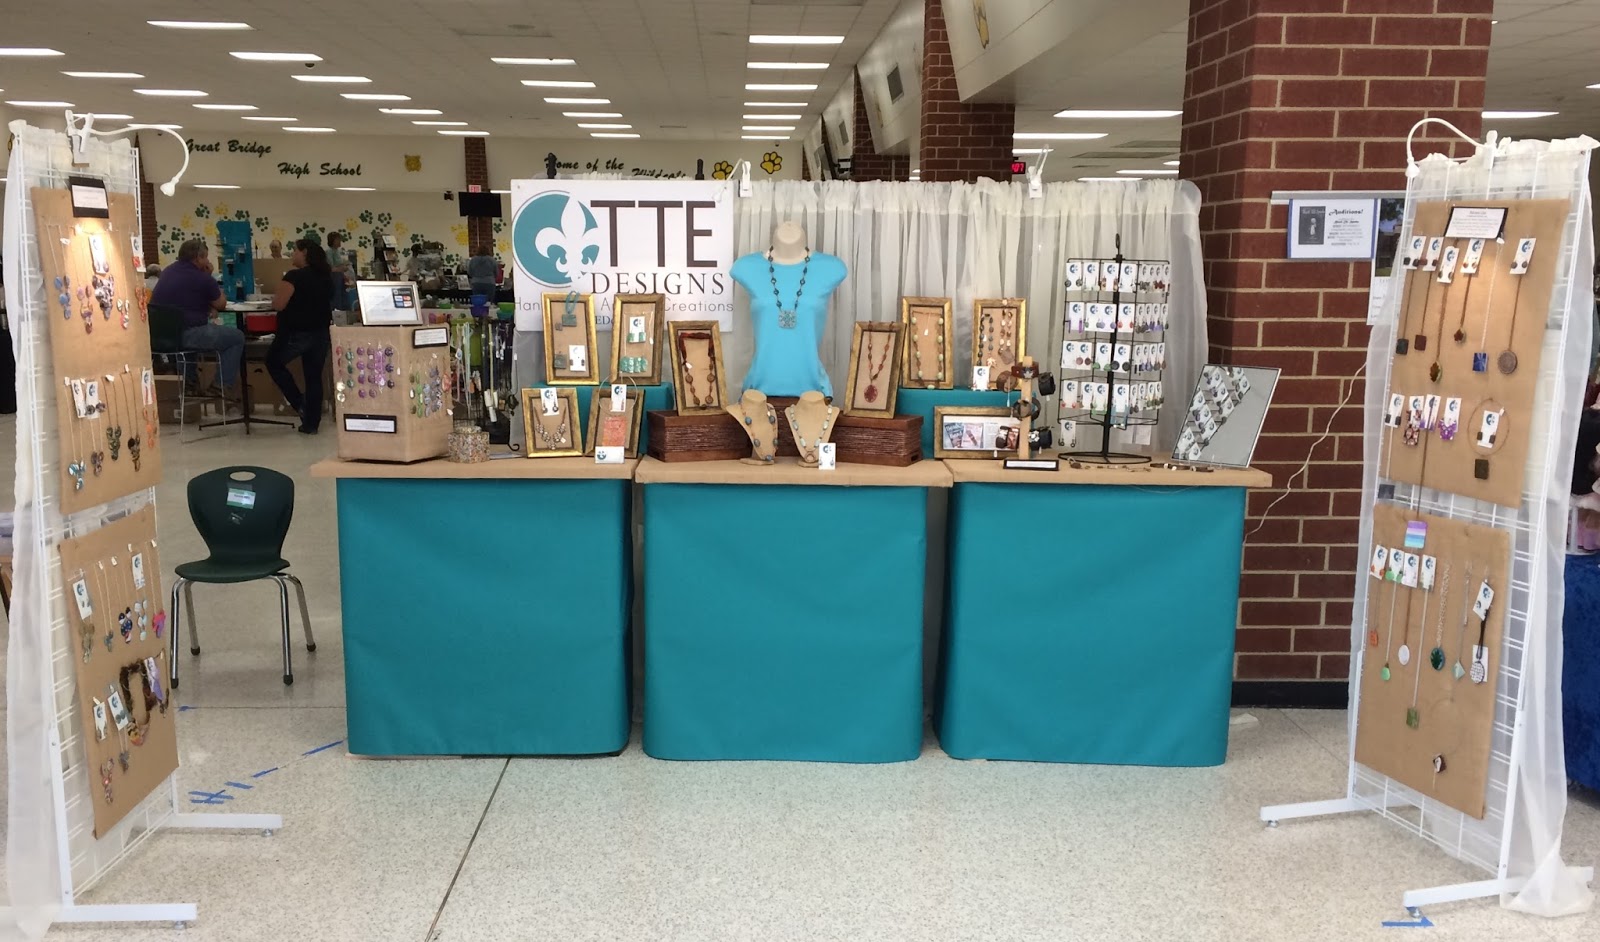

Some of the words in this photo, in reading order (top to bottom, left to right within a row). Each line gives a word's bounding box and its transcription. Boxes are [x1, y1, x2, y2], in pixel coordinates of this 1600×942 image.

[186, 139, 220, 154] Great
[228, 140, 271, 158] Bridge
[277, 162, 310, 179] High
[320, 162, 361, 176] School
[586, 158, 599, 172] of
[606, 157, 625, 170] the
[590, 200, 718, 267] TTE
[592, 272, 724, 295] DESIGNS
[665, 297, 734, 312] Creations
